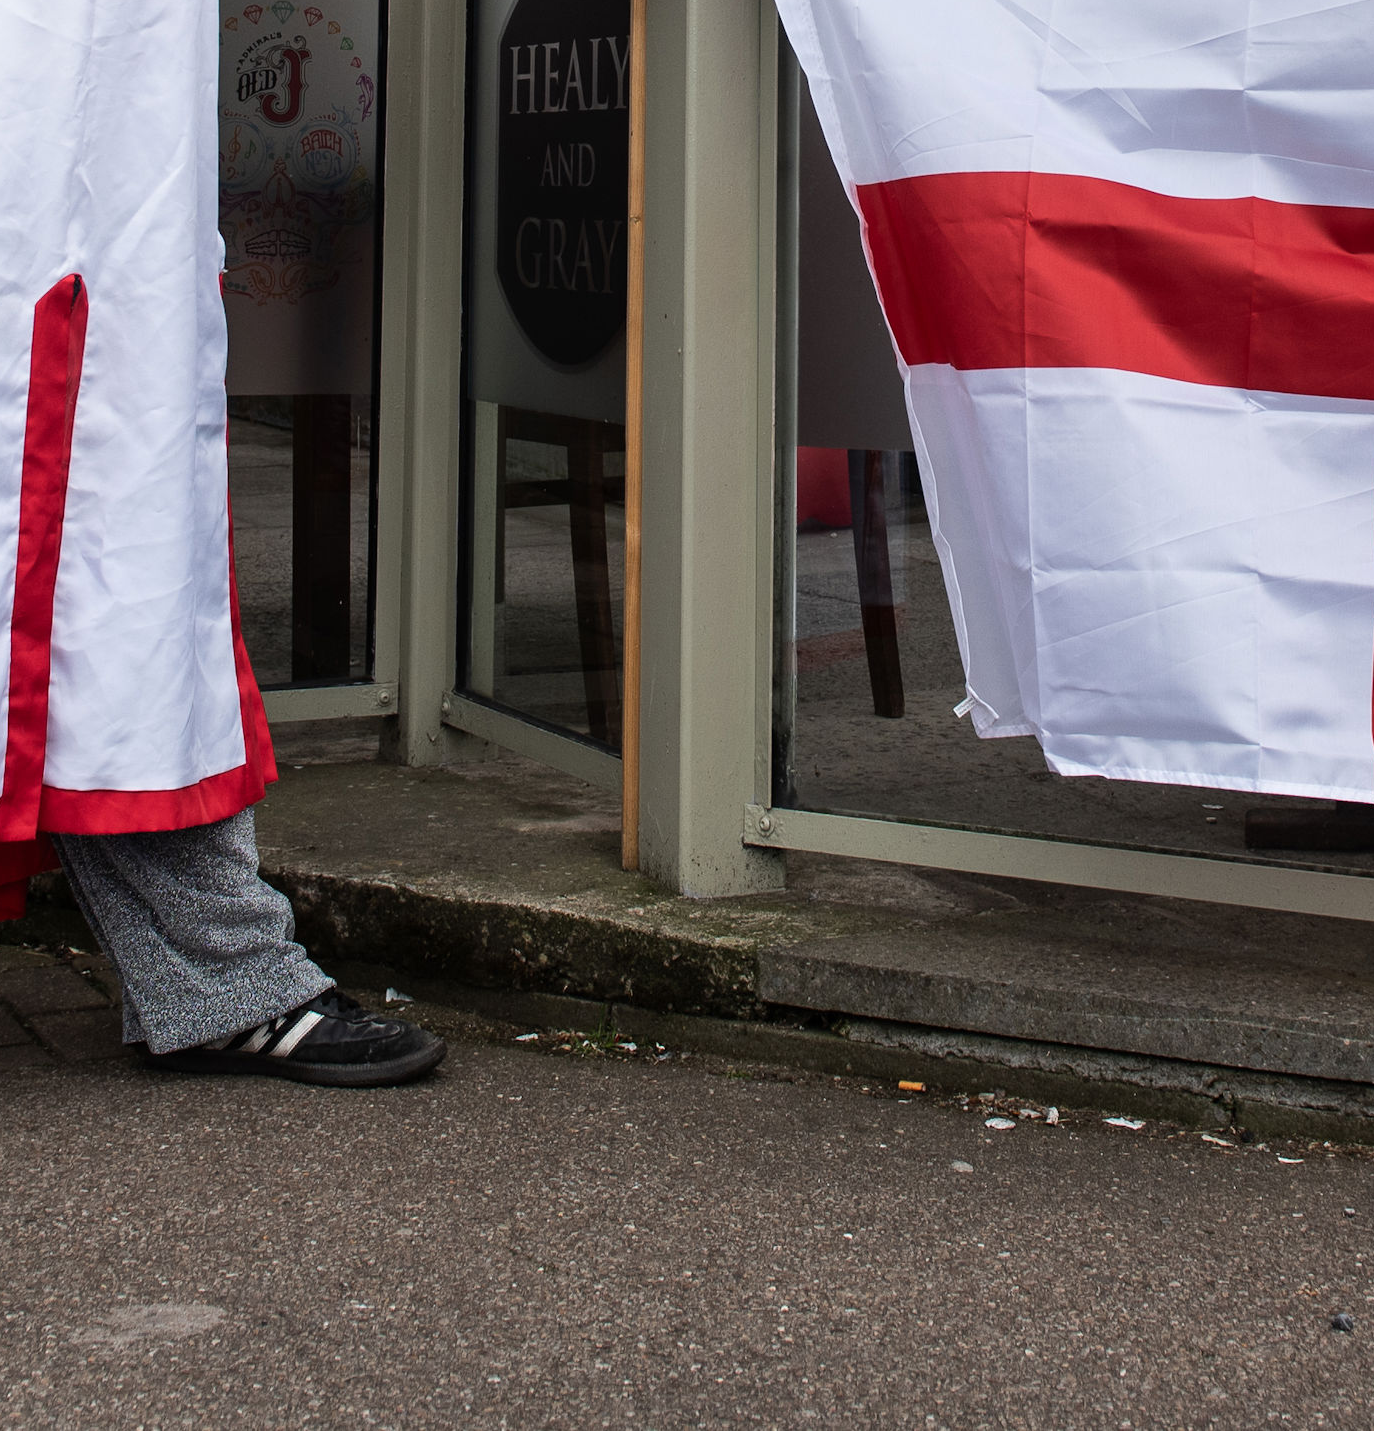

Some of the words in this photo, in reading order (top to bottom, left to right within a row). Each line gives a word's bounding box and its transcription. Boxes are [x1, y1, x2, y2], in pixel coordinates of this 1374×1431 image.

[236, 69, 277, 102] OLD
[257, 46, 313, 126] J
[509, 36, 630, 114] HEALY
[539, 143, 596, 187] AND
[515, 216, 622, 294] GRAY
